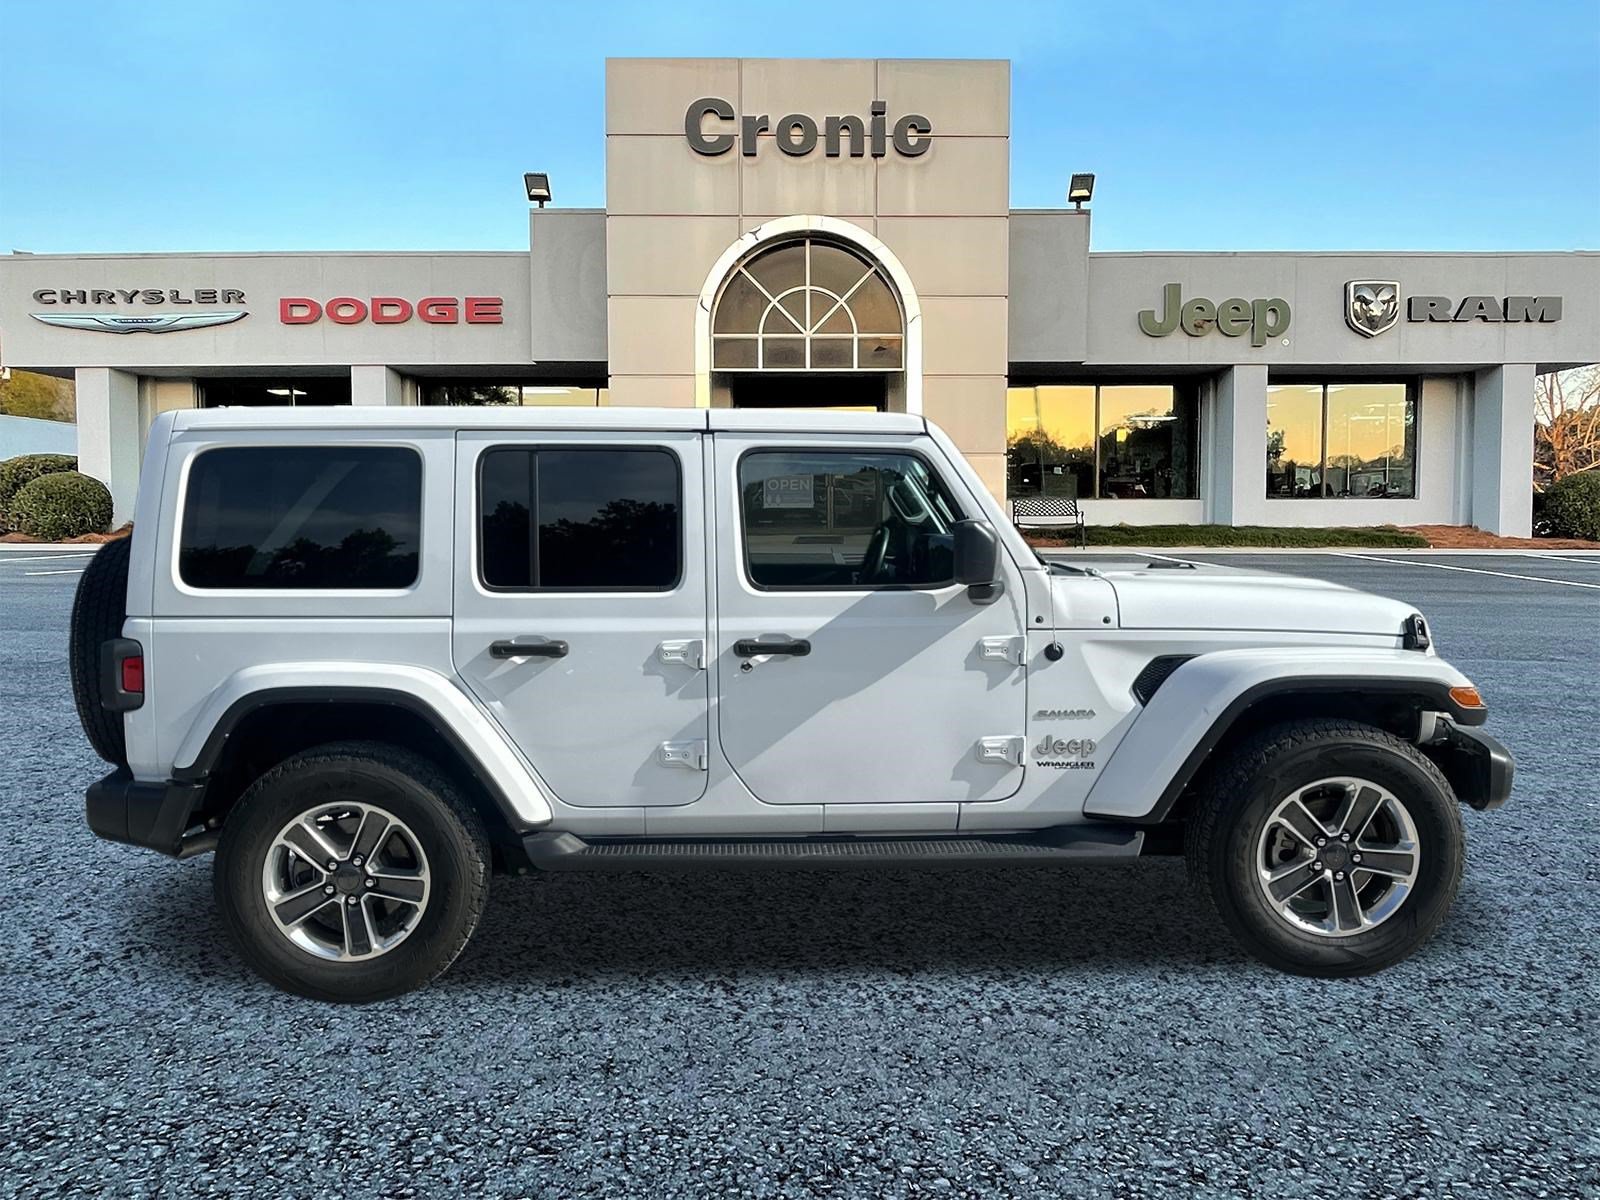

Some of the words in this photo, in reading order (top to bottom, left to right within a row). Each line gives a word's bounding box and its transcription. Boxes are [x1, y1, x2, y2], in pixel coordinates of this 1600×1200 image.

[685, 97, 932, 157] Cronic
[32, 288, 247, 305] CHRYSLER
[280, 297, 504, 325] DODGE
[1138, 283, 1291, 346] Jeep
[1407, 296, 1562, 322] RAM
[767, 479, 810, 490] OPEN
[1036, 709, 1096, 718] SAHARA
[1036, 735, 1096, 758] Jeep
